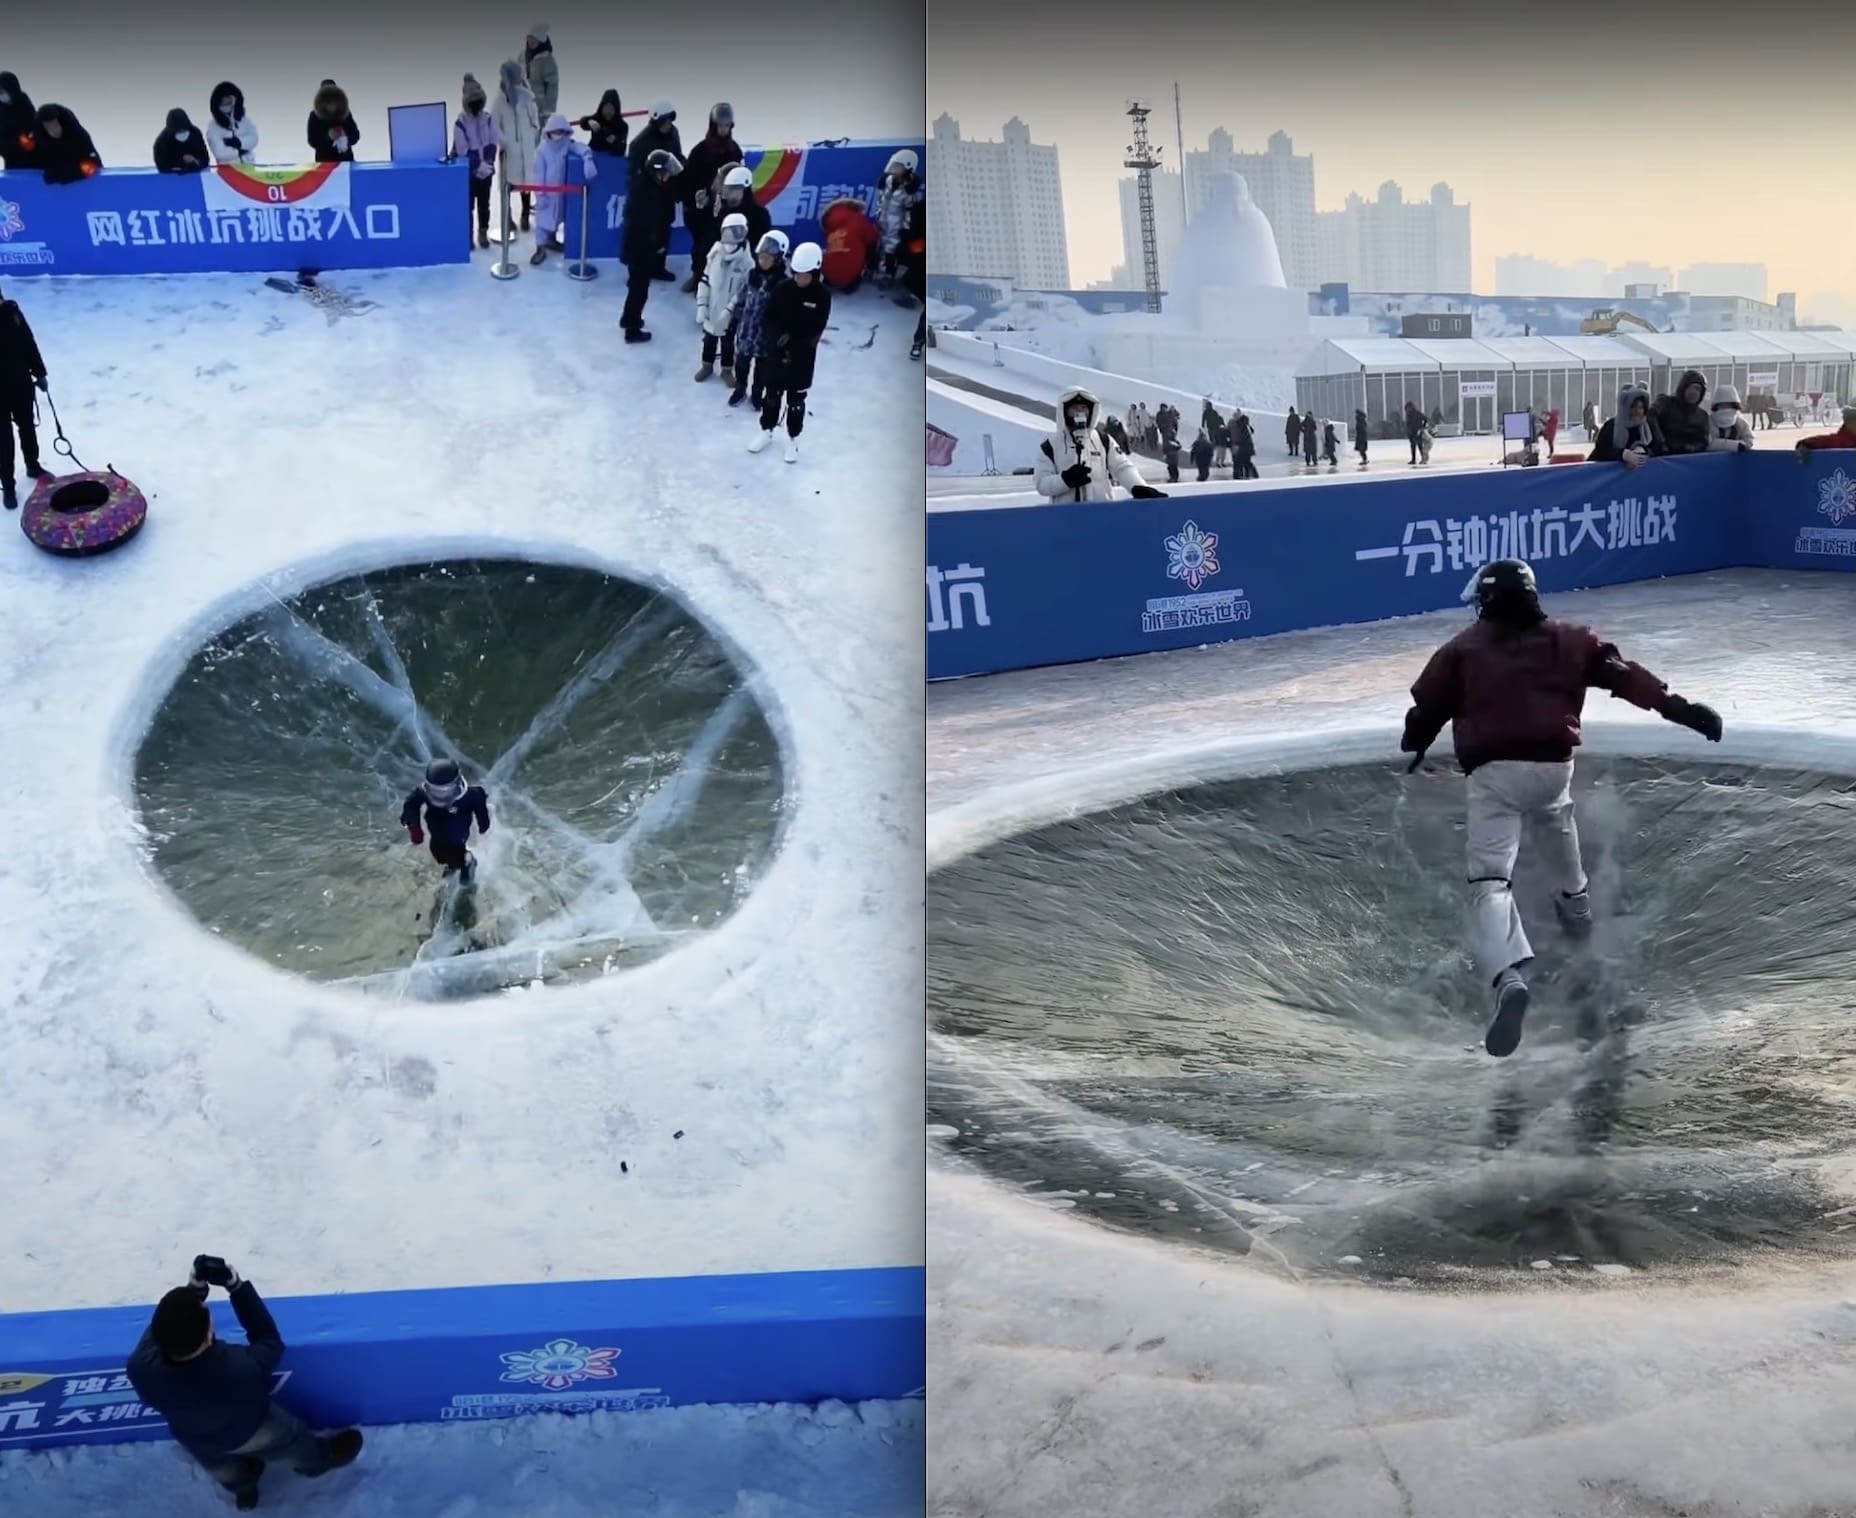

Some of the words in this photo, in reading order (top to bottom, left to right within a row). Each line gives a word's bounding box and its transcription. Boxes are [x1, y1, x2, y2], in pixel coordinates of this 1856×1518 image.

[86, 203, 401, 247] 网红冰坑挑战入口
[1355, 495, 1677, 577] 一分钟冰坑大挑战
[1141, 600, 1252, 632] 冰雪欢乐世界
